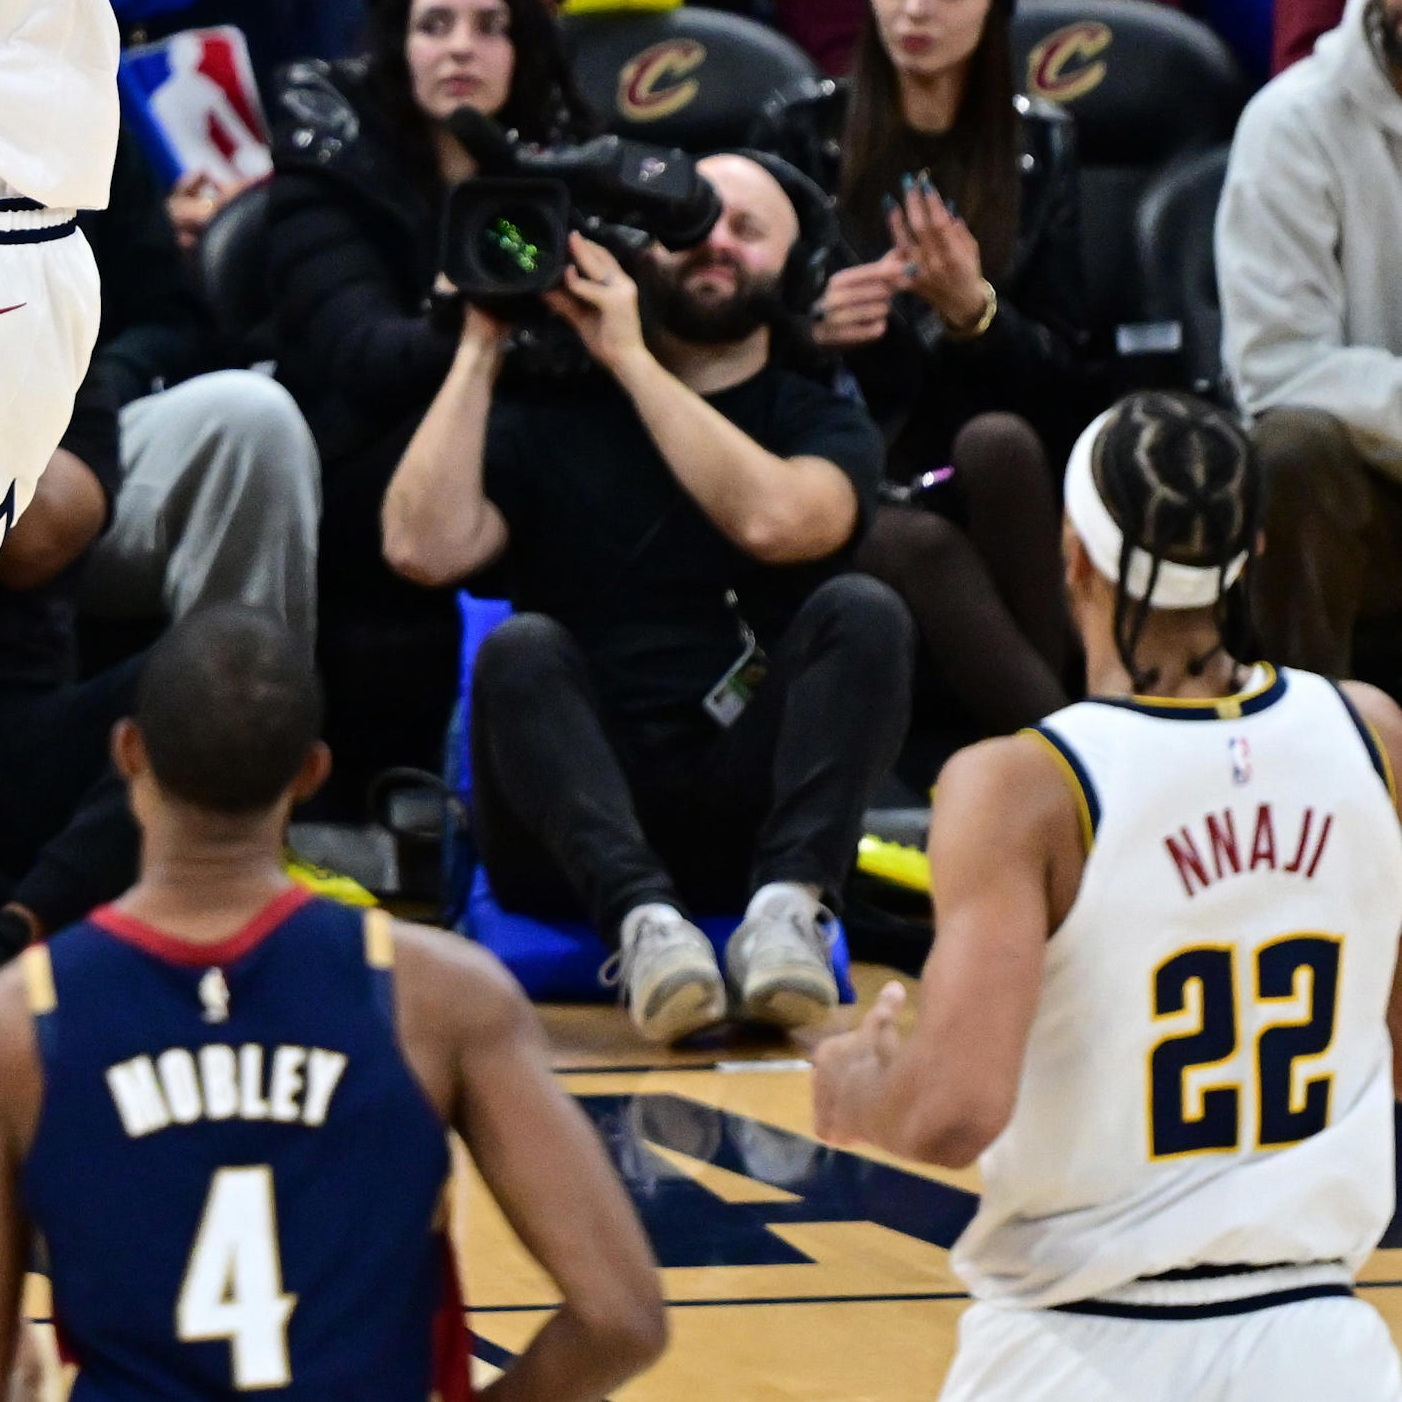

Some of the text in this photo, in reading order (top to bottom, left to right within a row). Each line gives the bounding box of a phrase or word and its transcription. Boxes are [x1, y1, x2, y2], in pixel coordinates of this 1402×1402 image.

[1164, 803, 1335, 898] NNAJI
[105, 1043, 349, 1138] MOBLEY
[1147, 932, 1345, 1162] 22
[175, 1163, 299, 1391] 4
